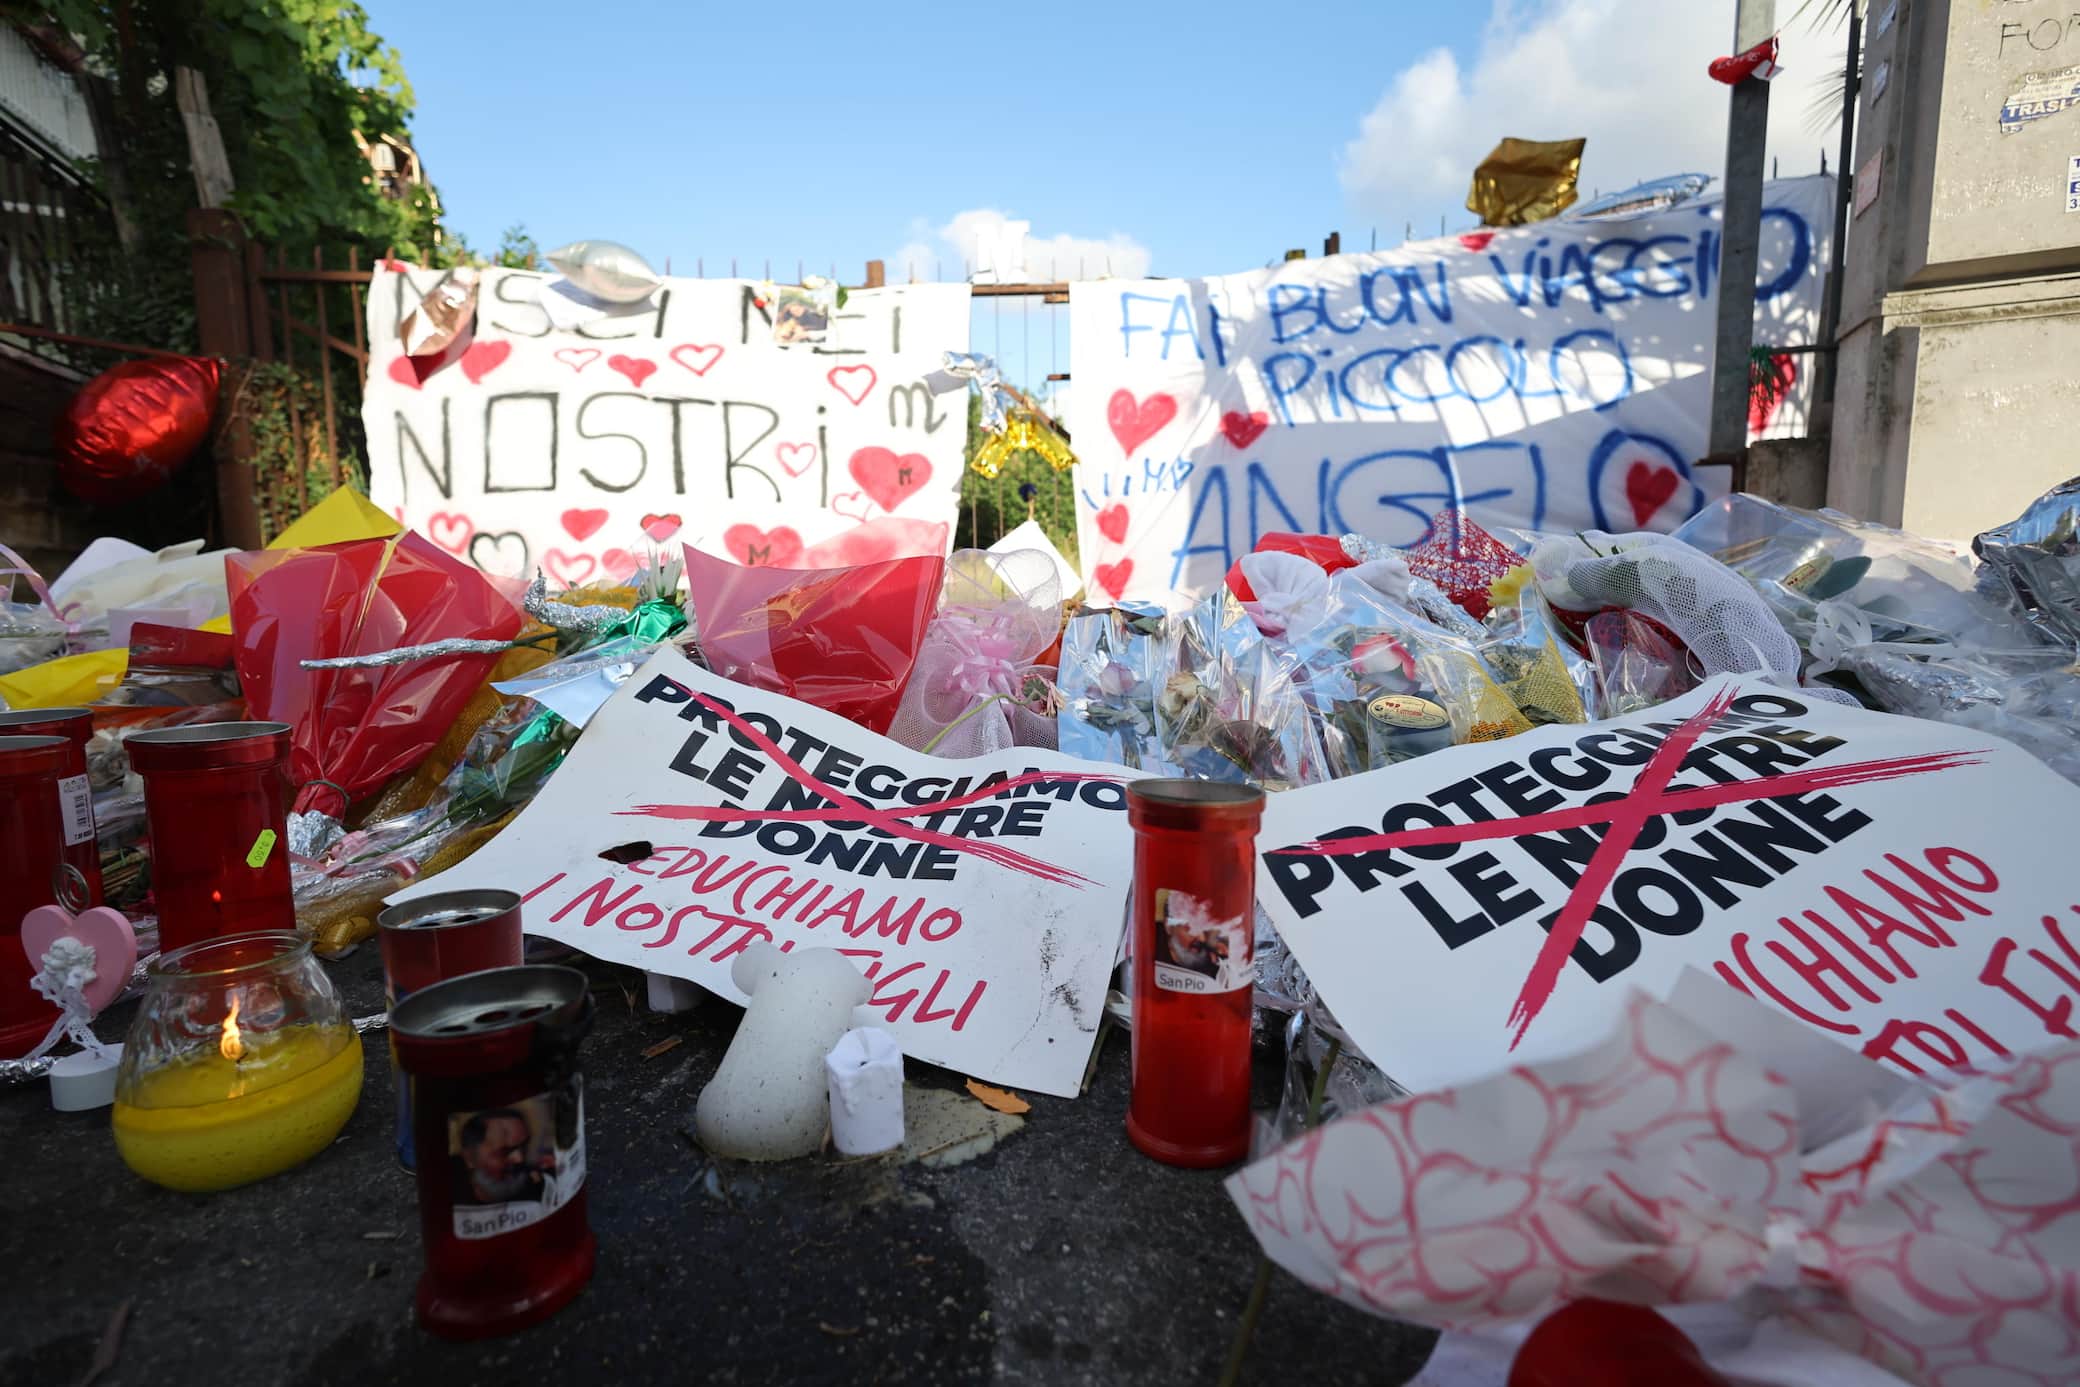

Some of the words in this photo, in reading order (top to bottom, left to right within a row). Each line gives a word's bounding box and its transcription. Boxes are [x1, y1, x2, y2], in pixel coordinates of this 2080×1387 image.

[1268, 261, 1451, 344] BUON
[634, 673, 1129, 811] PROTEGGIAMO
[668, 731, 766, 799] LE
[764, 776, 1051, 840] NOSTRE
[698, 800, 960, 881] DONNE
[1262, 694, 1808, 918] PROTEGGIAMO
[1400, 852, 1547, 949] LE
[1514, 725, 1846, 887] NOSTRE
[626, 846, 962, 945] EDUCHIAMO
[1537, 790, 1874, 984] DONNE
[1160, 974, 1183, 988] San
[1185, 978, 1205, 991] Pio
[462, 1218, 497, 1235] San
[499, 1209, 527, 1228] Pio
